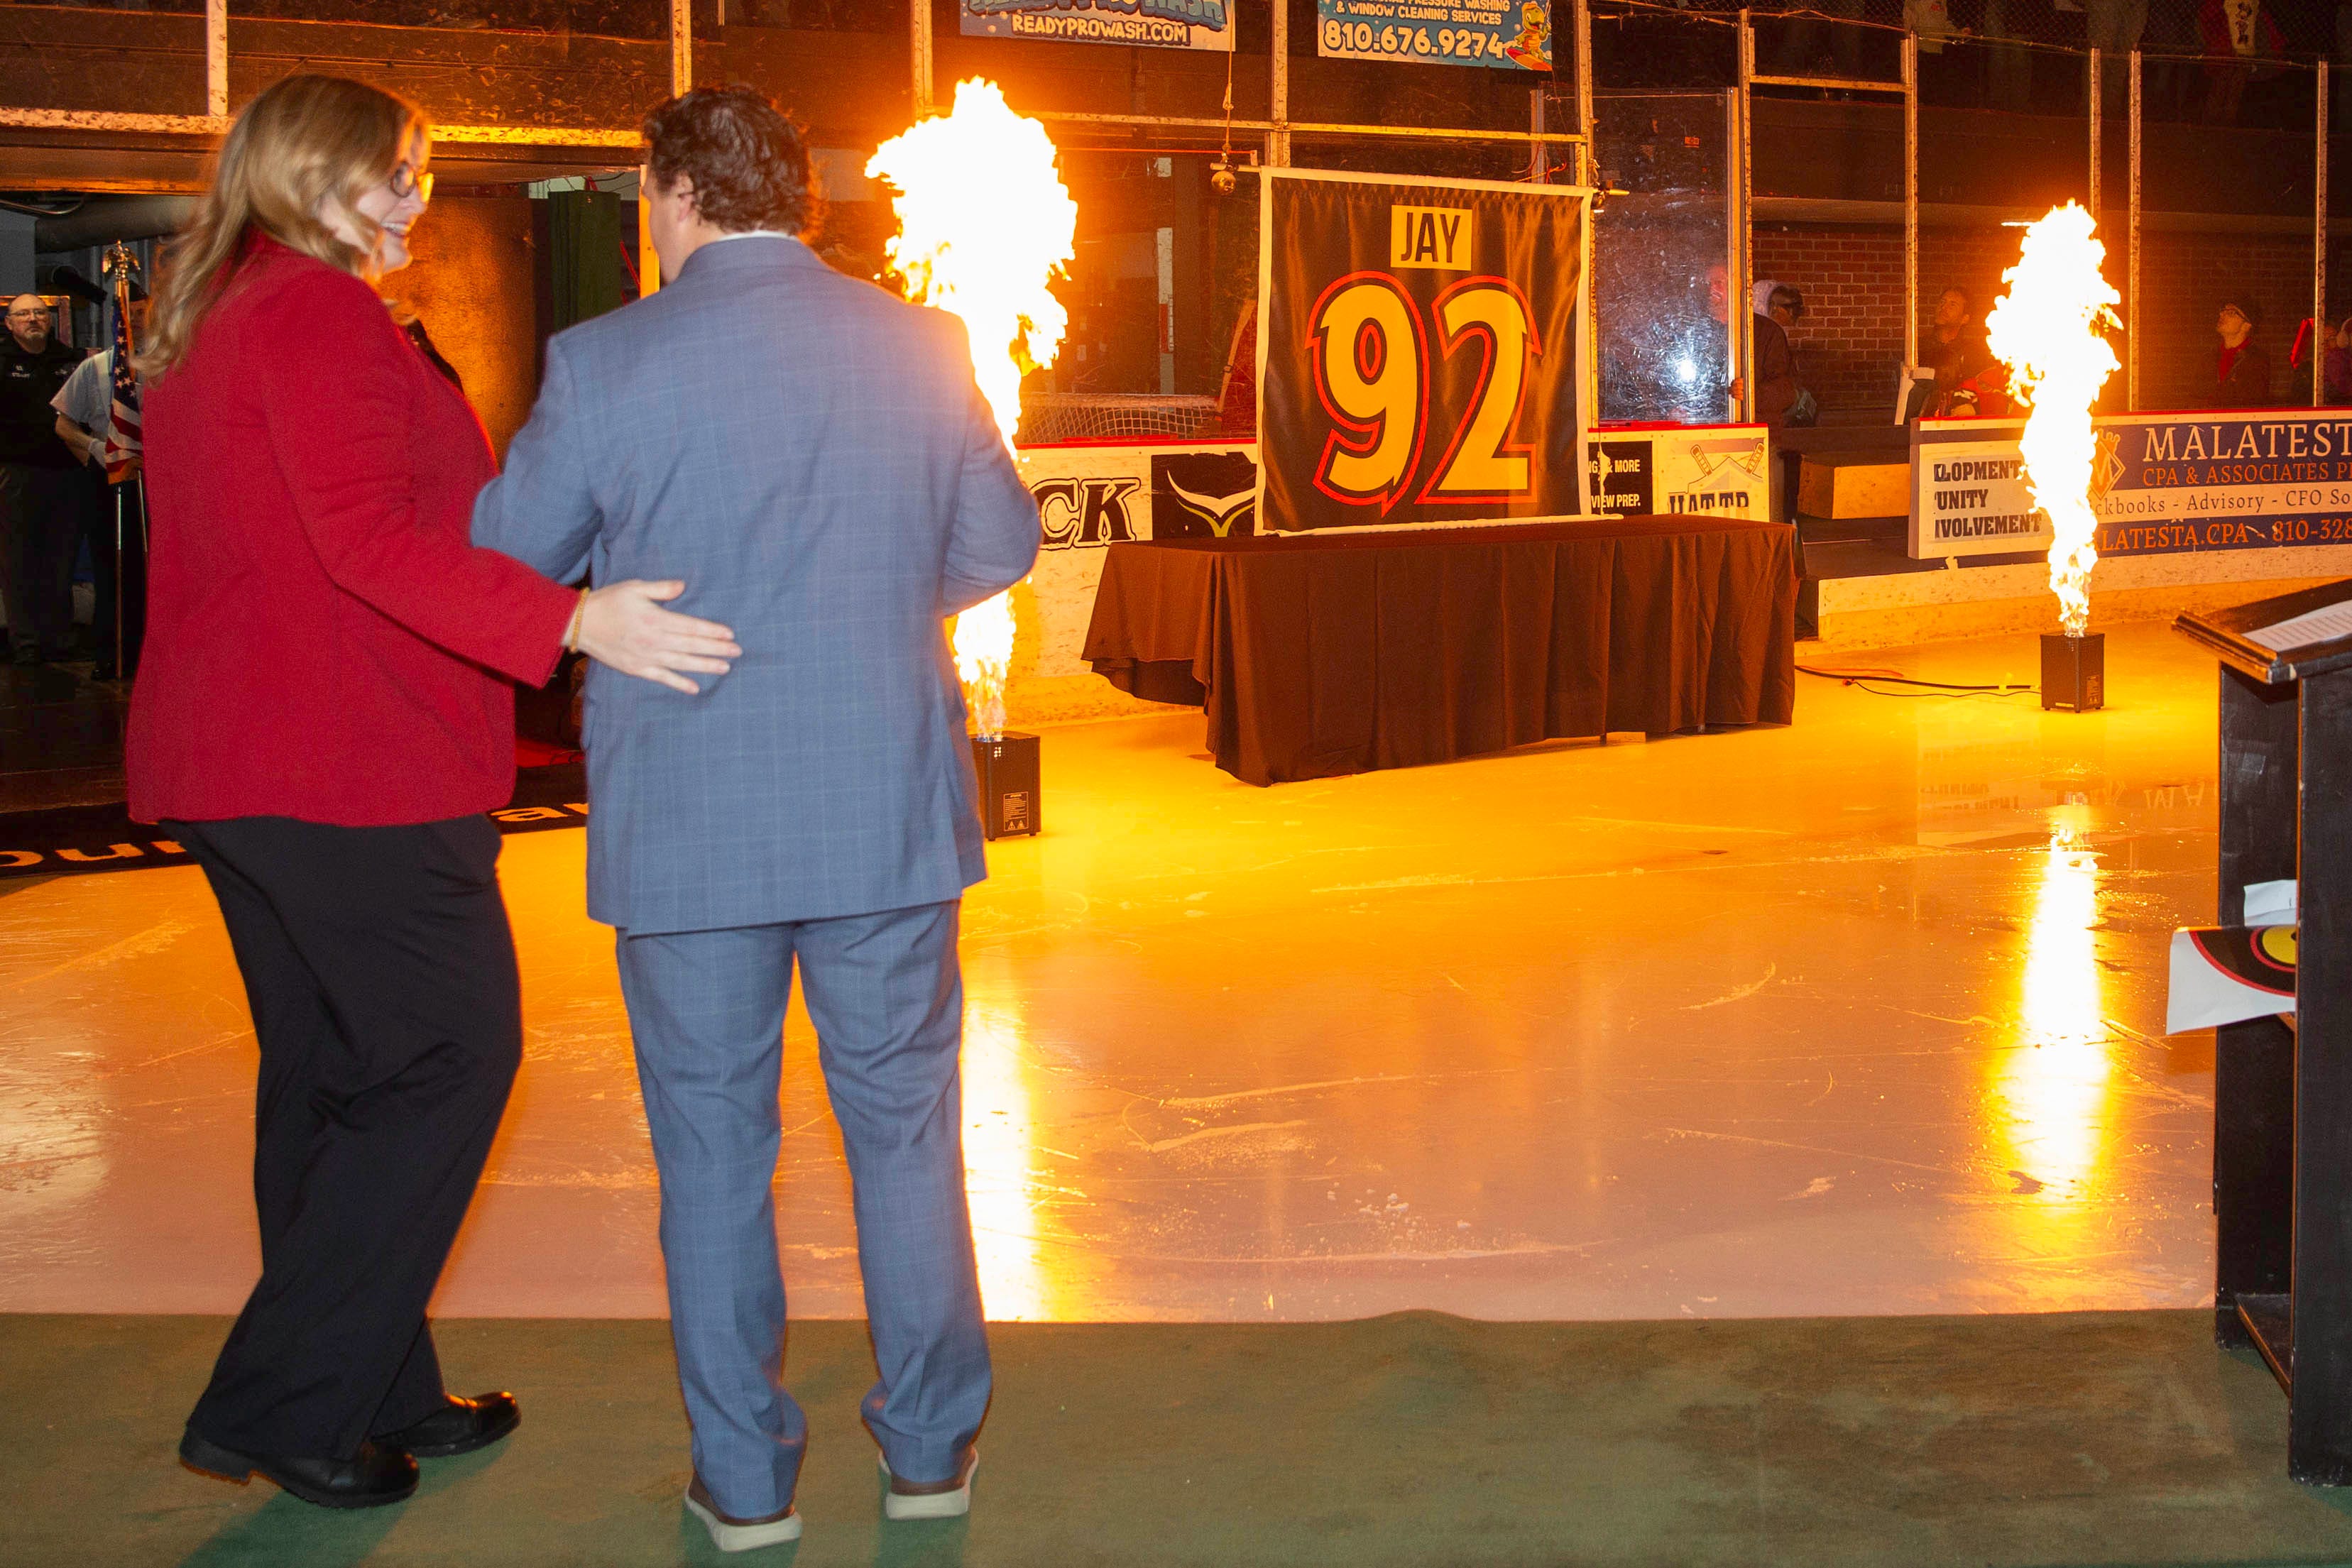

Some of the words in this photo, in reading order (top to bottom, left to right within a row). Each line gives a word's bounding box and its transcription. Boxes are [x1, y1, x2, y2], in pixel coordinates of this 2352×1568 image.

[1336, 1, 1345, 13] &
[1348, 3, 1395, 16] WINDOW
[1398, 6, 1448, 21] CLEANING
[1452, 10, 1502, 25] SERVICES
[1465, 0, 1510, 11] WASHING
[1012, 14, 1188, 42] READYPROWASH.COM
[1323, 20, 1504, 58] 810.676.9274
[1401, 212, 1460, 263] JAY
[1309, 274, 1539, 514] 92
[2142, 423, 2352, 461] MALATEST
[1614, 459, 1641, 473] MORE
[2143, 467, 2179, 486] CPA
[2186, 466, 2199, 484] &
[2206, 463, 2329, 483] ASSOCIATES
[2337, 461, 2352, 479] P
[1617, 493, 1641, 507] PREP.
[2187, 492, 2264, 512] Advisory
[2286, 489, 2321, 506] CFO
[2330, 488, 2351, 505] So
